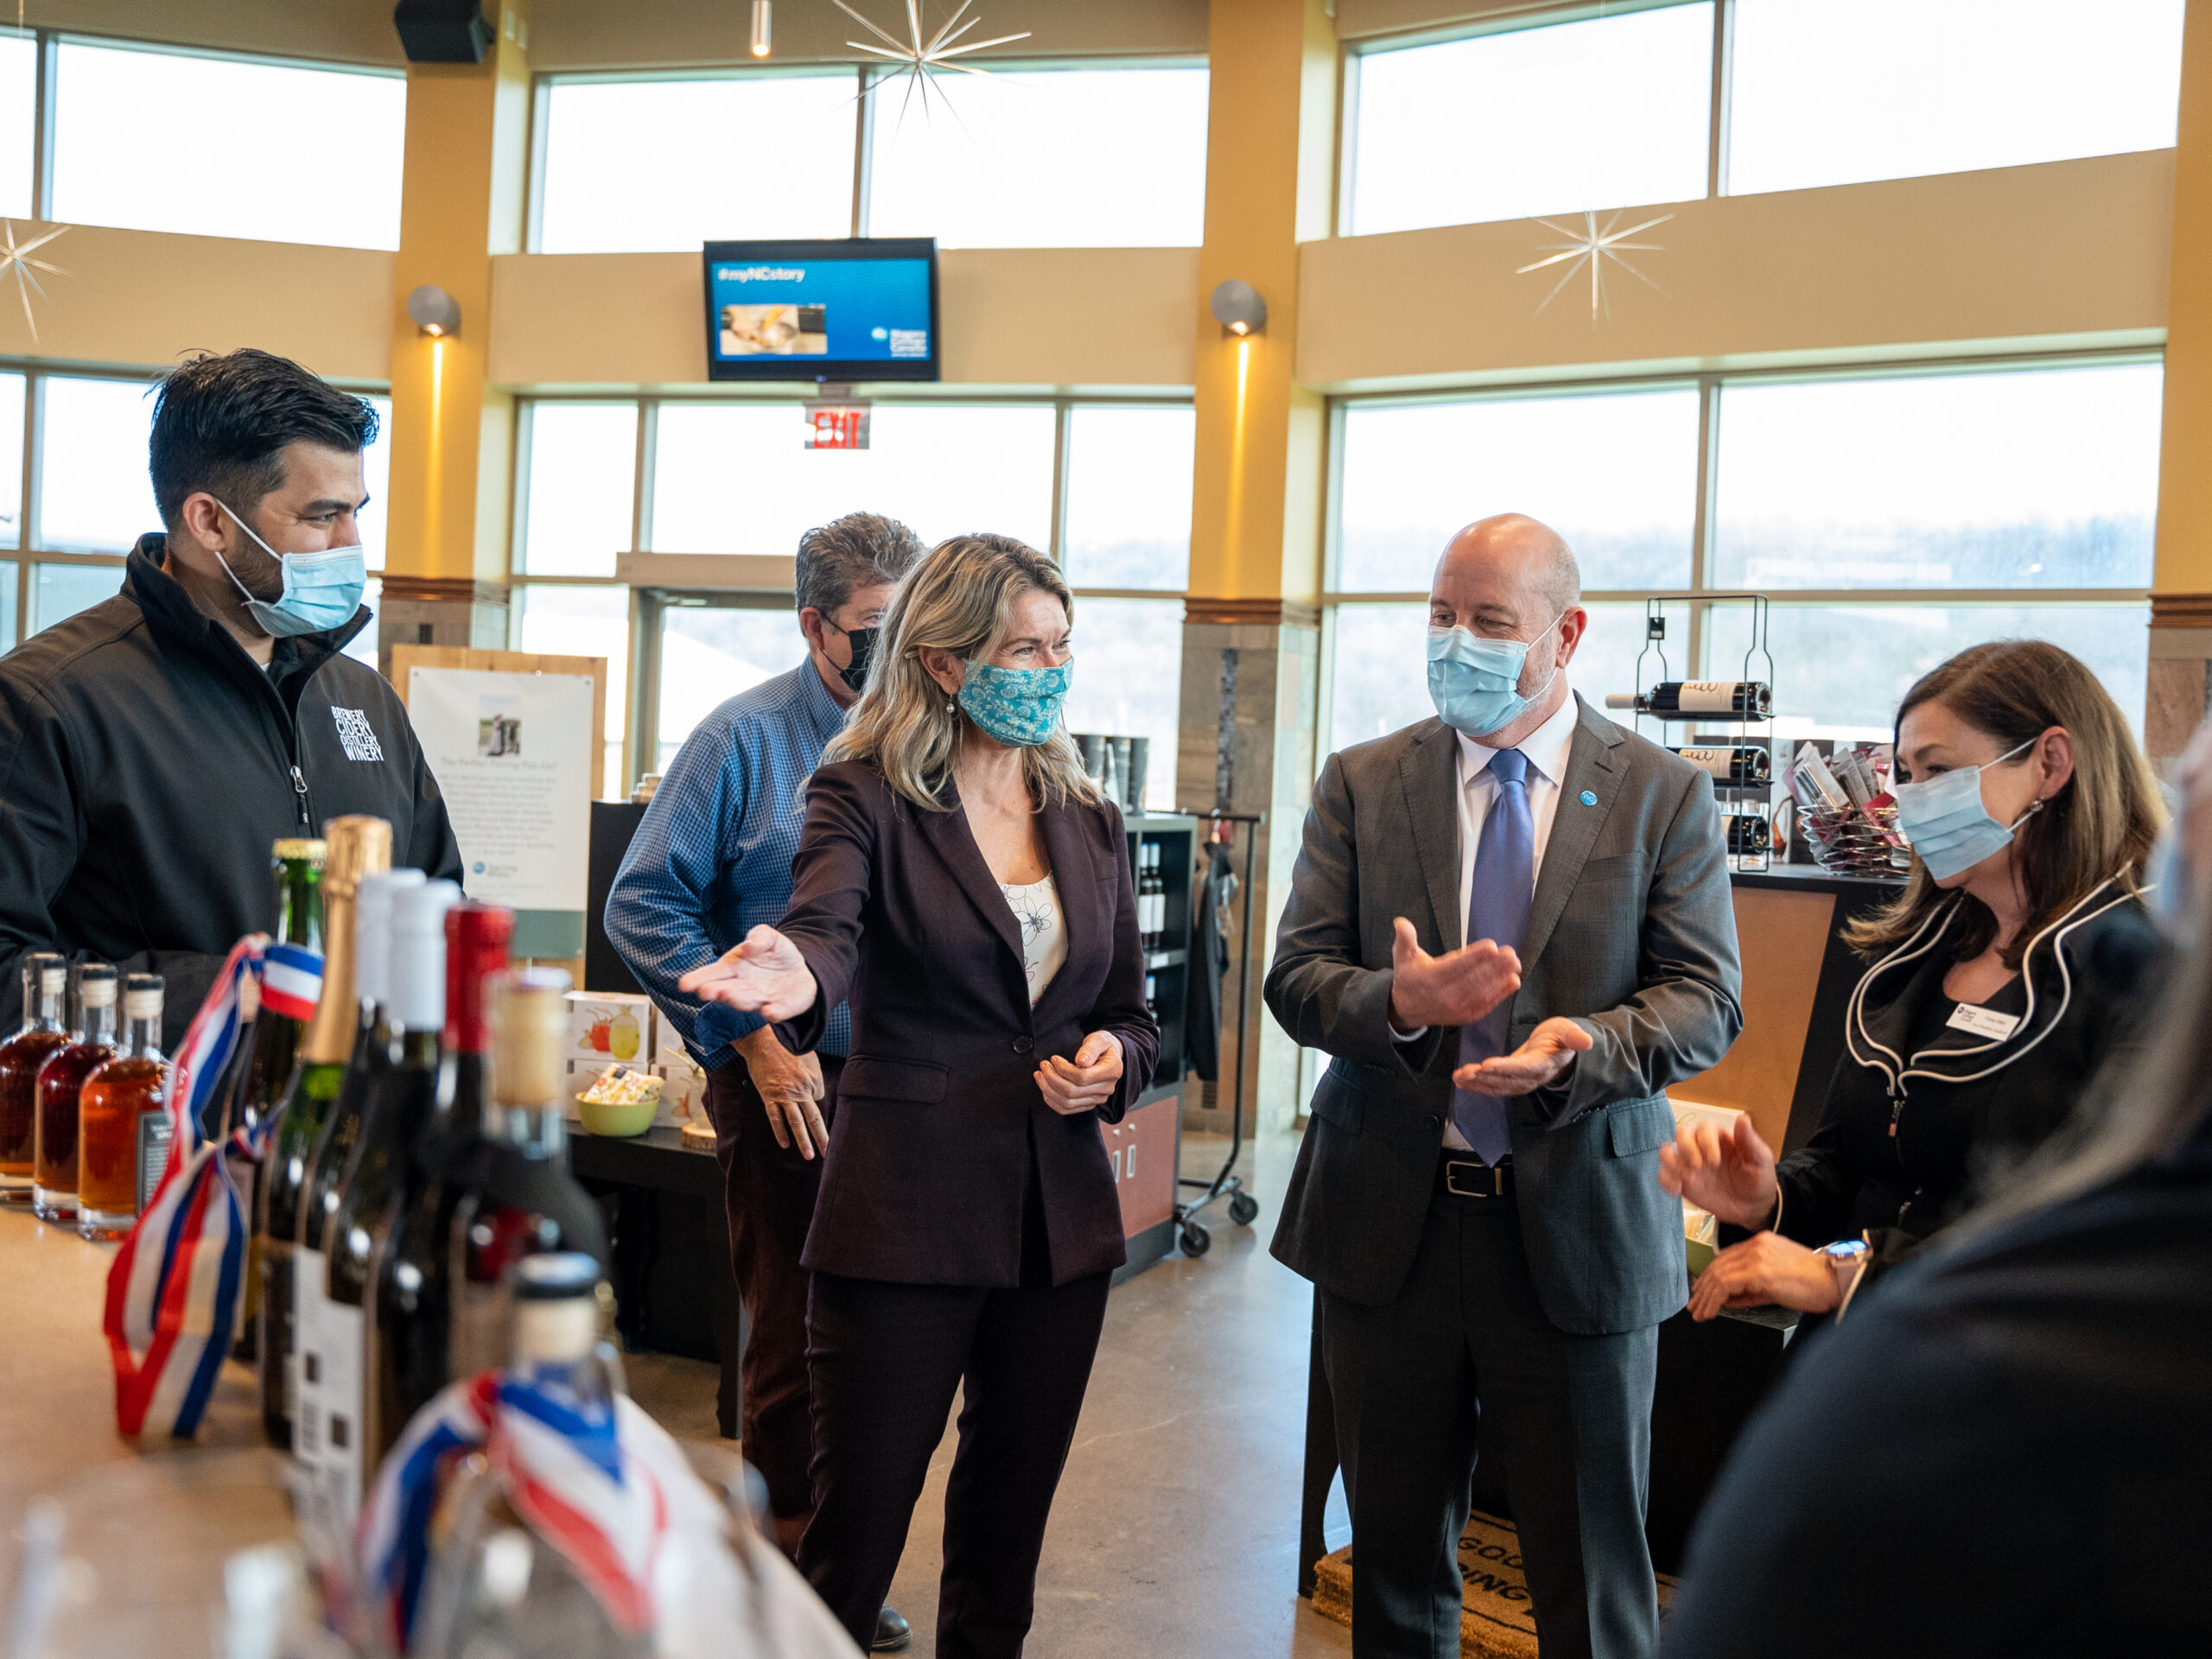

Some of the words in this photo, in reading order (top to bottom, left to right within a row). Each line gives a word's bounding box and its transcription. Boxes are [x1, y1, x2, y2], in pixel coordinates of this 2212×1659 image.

[718, 266, 805, 283] #myNCstory
[813, 412, 861, 448] EXIT
[331, 705, 367, 721] BREWERY
[335, 719, 374, 737] CIDERY
[340, 734, 379, 747] DISTILLERY
[343, 745, 384, 761] WINERY
[1458, 1537, 1523, 1570] GOO
